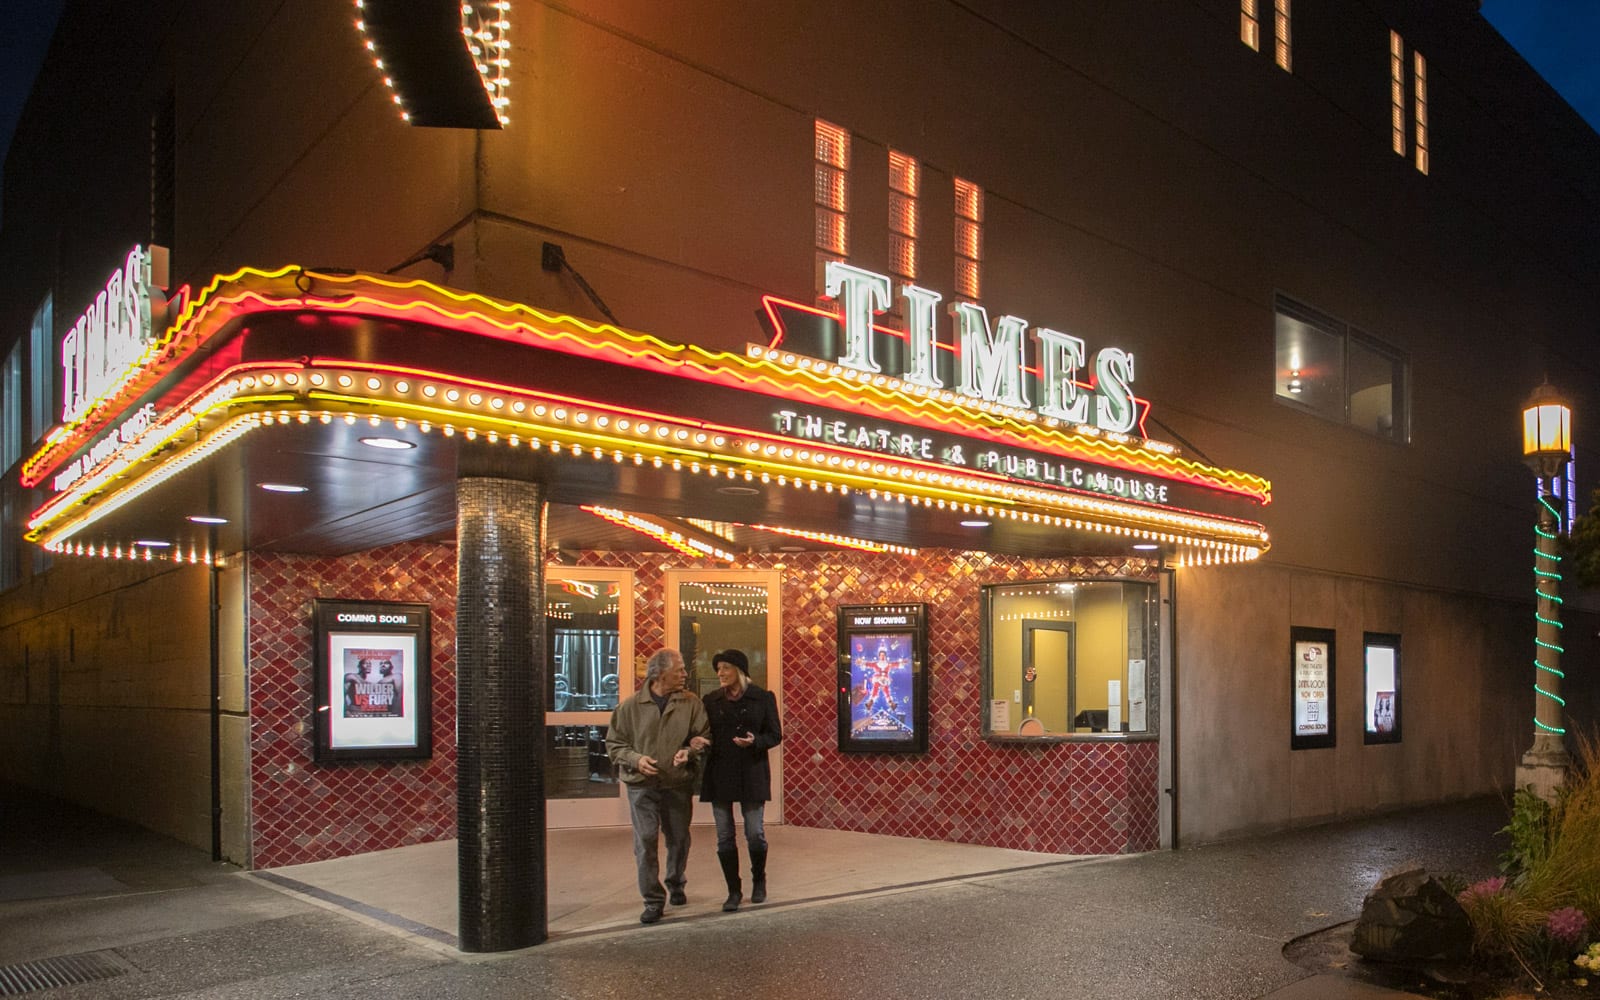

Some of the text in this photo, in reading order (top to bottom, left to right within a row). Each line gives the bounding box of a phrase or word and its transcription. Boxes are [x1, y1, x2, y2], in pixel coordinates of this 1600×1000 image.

[824, 260, 1138, 434] TIMES
[776, 409, 1169, 503] THEATRE & PUBLIC HOUSE
[336, 613, 407, 624] COMING SOON
[854, 616, 906, 625] NOW SHOWING
[355, 683, 394, 695] WILDER
[354, 694, 394, 706] VS FURY
